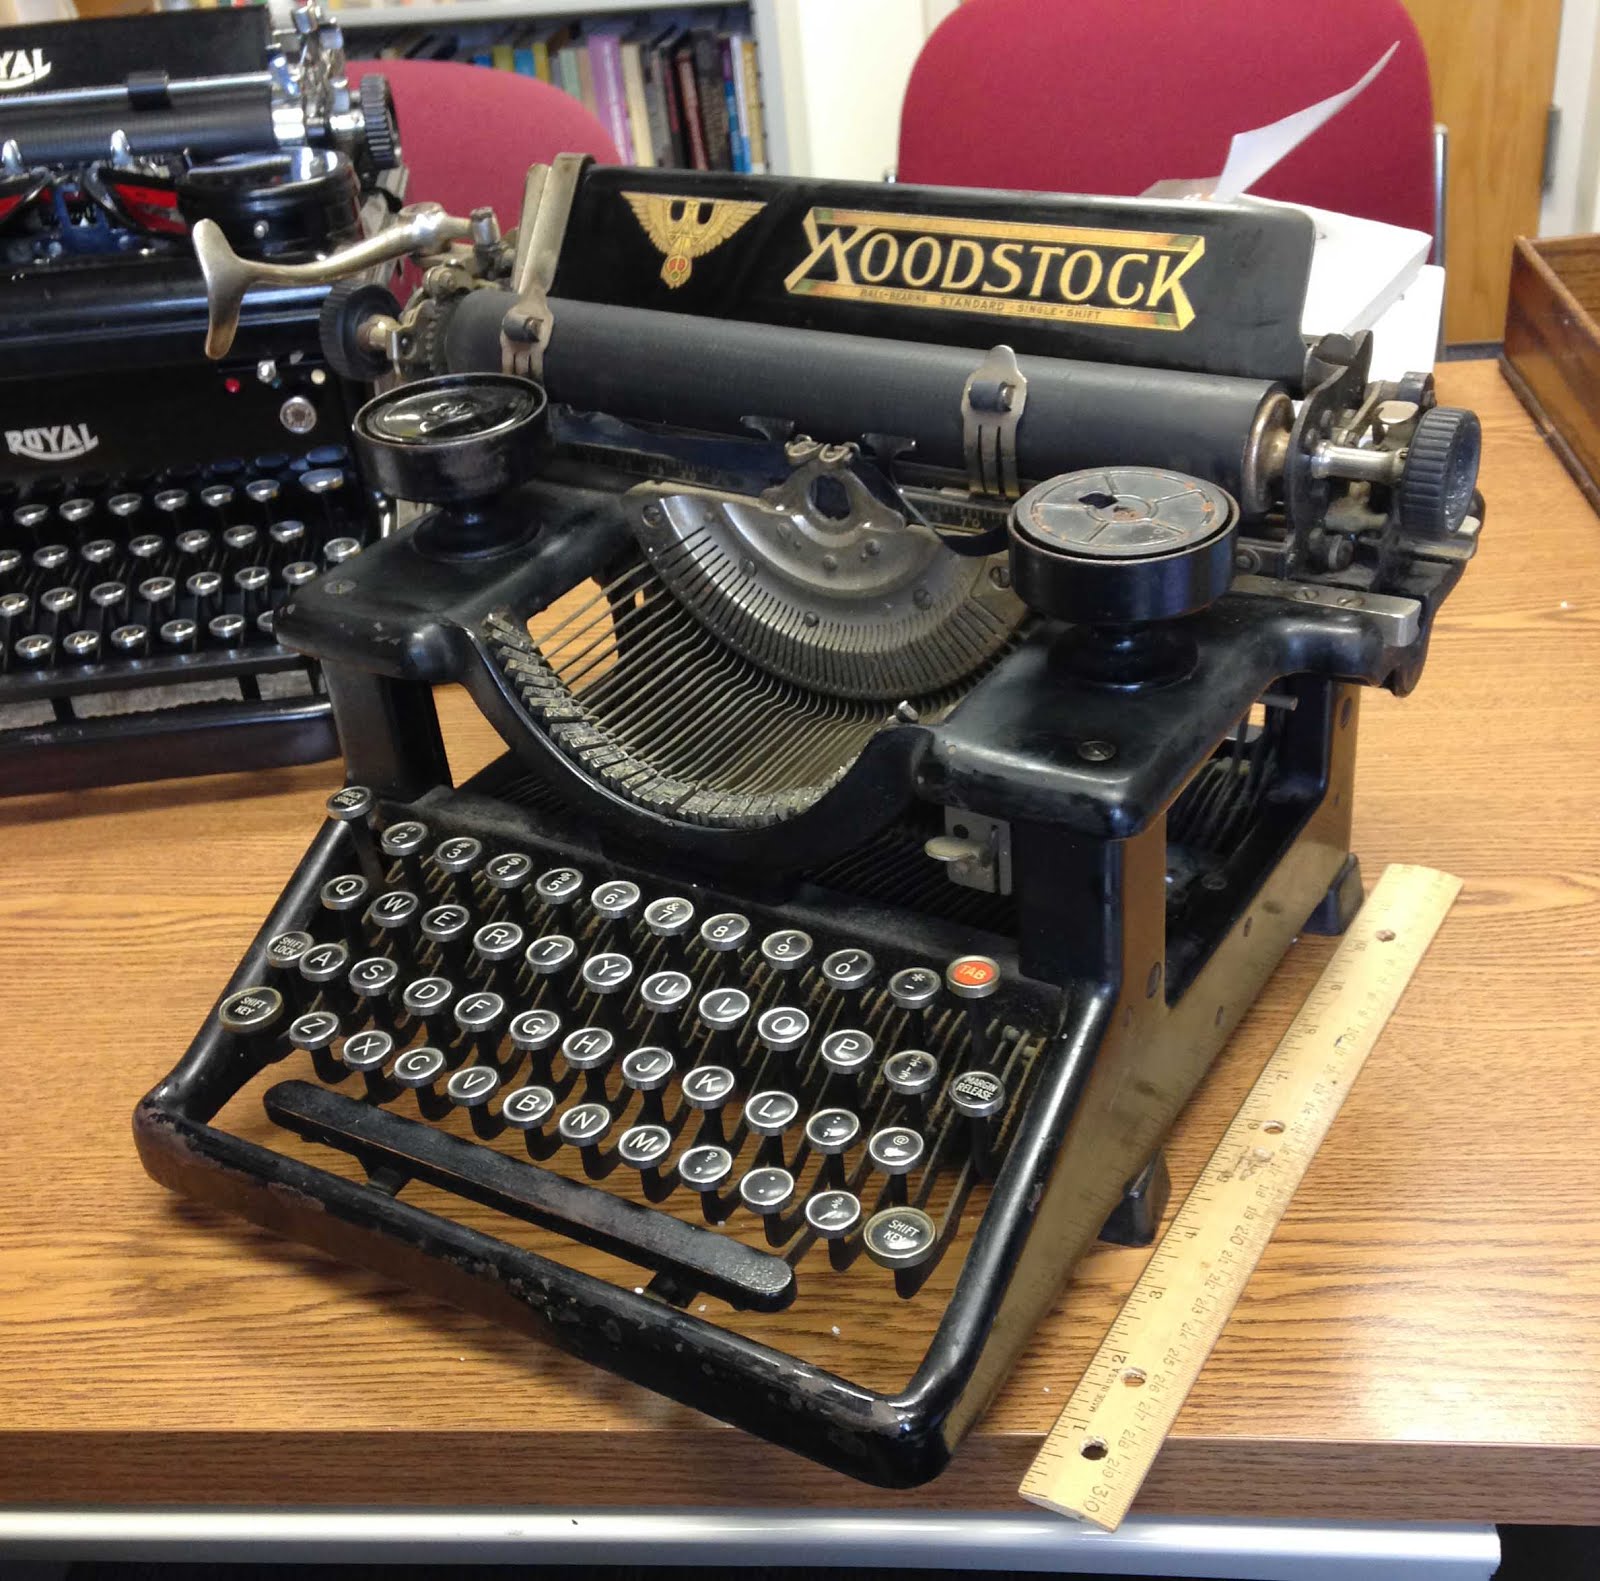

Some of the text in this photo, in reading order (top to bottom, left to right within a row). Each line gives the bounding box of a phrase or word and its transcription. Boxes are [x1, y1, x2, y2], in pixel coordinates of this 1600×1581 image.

[784, 207, 1205, 331] WOODSTOCK
[940, 296, 1004, 311] STANDARD
[4, 423, 99, 460] ROYAL
[391, 832, 408, 843] 2
[446, 848, 462, 859] 3
[496, 865, 511, 876] 4
[335, 880, 357, 896] Q
[547, 880, 564, 892] 5
[383, 896, 410, 912] W
[602, 893, 619, 905] 6
[433, 911, 458, 927] E
[658, 909, 675, 922] 7
[484, 928, 509, 945] R
[713, 925, 730, 938] 8
[273, 945, 297, 956] LOCK
[278, 936, 306, 950] SHIFT
[542, 941, 563, 956] T
[774, 943, 791, 956] 9
[310, 951, 333, 967] A
[361, 964, 384, 980] S
[598, 960, 621, 976] Y
[958, 964, 988, 981] TAB
[414, 984, 439, 1000] D
[655, 978, 679, 996] U
[234, 1005, 256, 1016] KEY
[240, 996, 267, 1009] SHIFT
[465, 999, 491, 1013] F
[300, 1018, 326, 1034] Z
[522, 1017, 546, 1035] G
[353, 1037, 381, 1056] X
[573, 1035, 600, 1054] H
[835, 1038, 860, 1054] P
[407, 1055, 431, 1071] C
[635, 1057, 660, 1072] J
[463, 1073, 486, 1089] V
[695, 1073, 721, 1093] K
[963, 1076, 999, 1093] MARGIN
[955, 1082, 994, 1101] RELEASE
[515, 1094, 540, 1112] B
[758, 1098, 775, 1118] L
[570, 1111, 597, 1130] N
[628, 1132, 659, 1152] M
[1255, 1183, 1269, 1198] 18
[1243, 1205, 1257, 1220] 19
[888, 1219, 920, 1237] SHIFT
[1230, 1225, 1249, 1246] 20
[883, 1230, 908, 1243] KEY
[1218, 1249, 1233, 1265] 21
[1204, 1273, 1221, 1290] 22
[1149, 1290, 1163, 1300] 3
[1191, 1297, 1206, 1315] 23
[1111, 1353, 1127, 1364] 2
[1163, 1347, 1180, 1367] 25
[1149, 1373, 1166, 1393] 26
[1088, 1394, 1106, 1412] MADE
[1135, 1401, 1151, 1421] 27
[1118, 1428, 1136, 1449] 28
[1102, 1458, 1120, 1479] 29
[1083, 1485, 1109, 1513] 30
